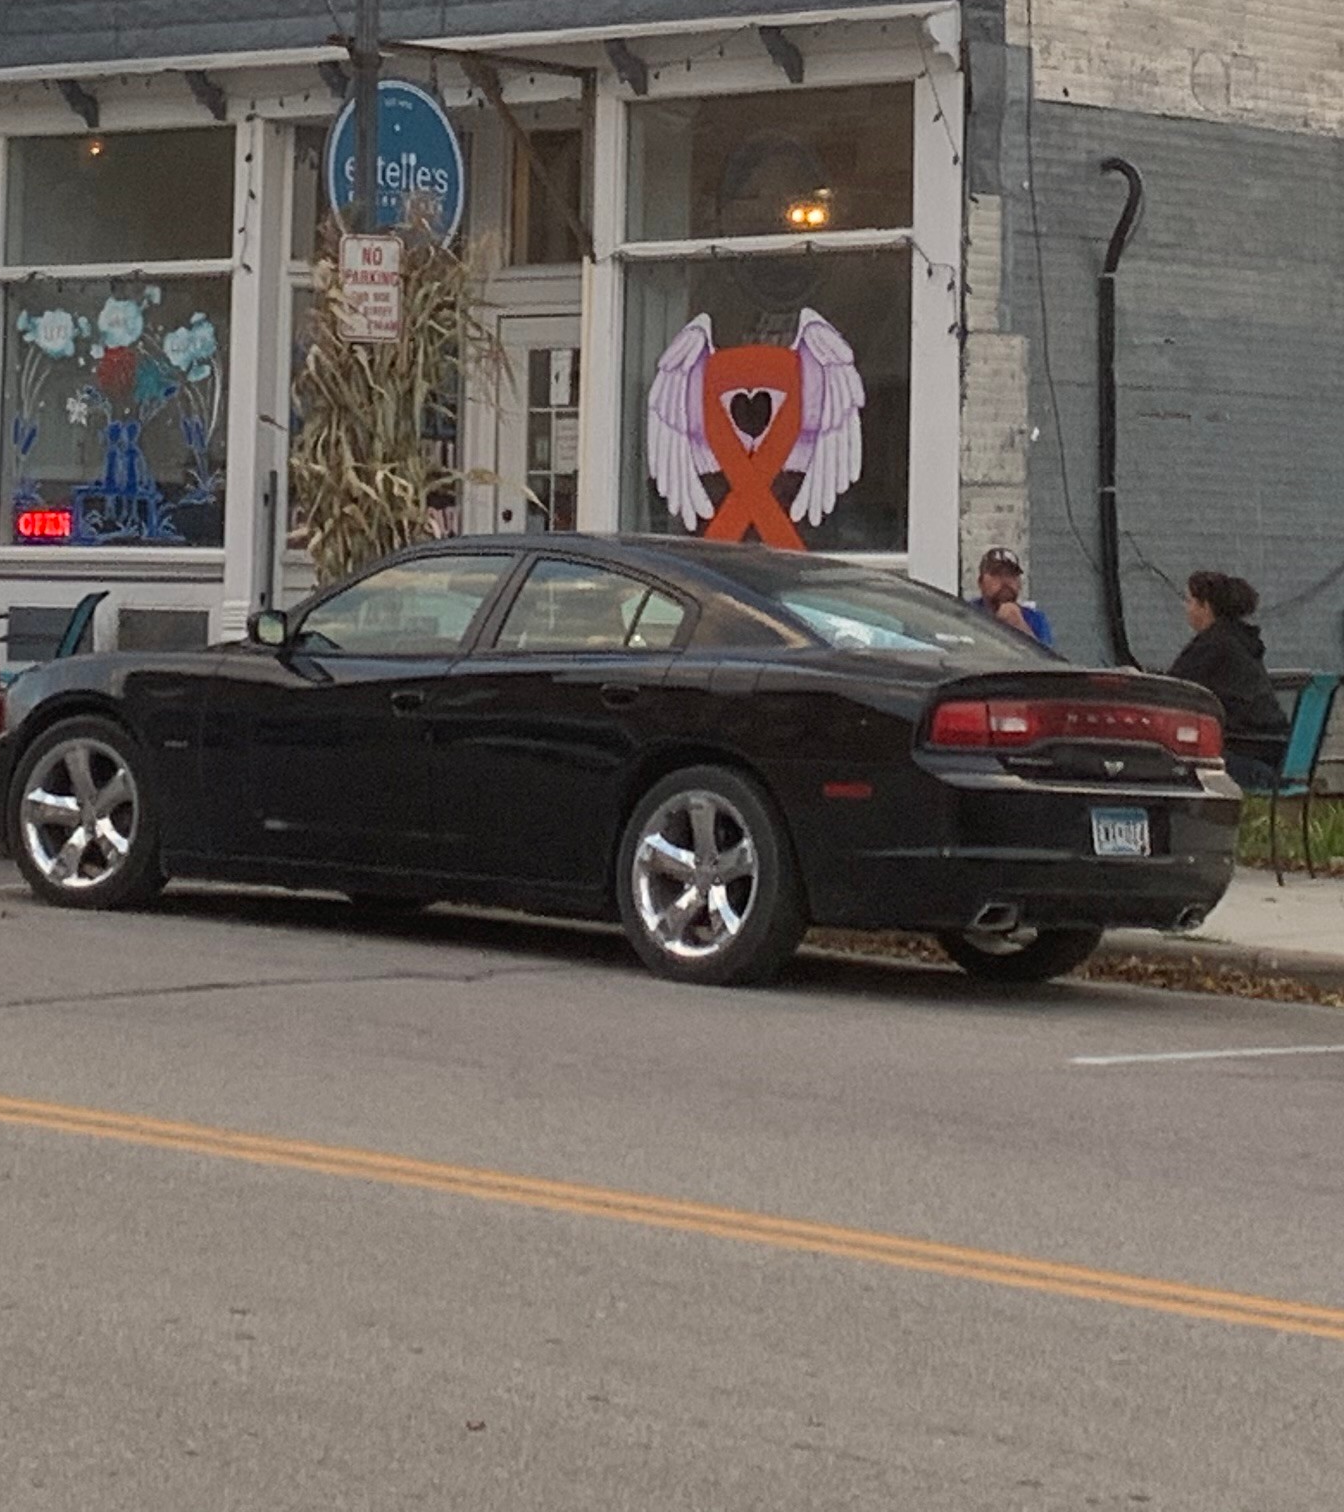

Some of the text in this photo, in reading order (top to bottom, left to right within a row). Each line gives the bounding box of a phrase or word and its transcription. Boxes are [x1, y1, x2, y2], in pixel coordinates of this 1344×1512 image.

[344, 152, 449, 194] etelle's
[361, 247, 383, 266] NO
[18, 511, 71, 537] OPEN
